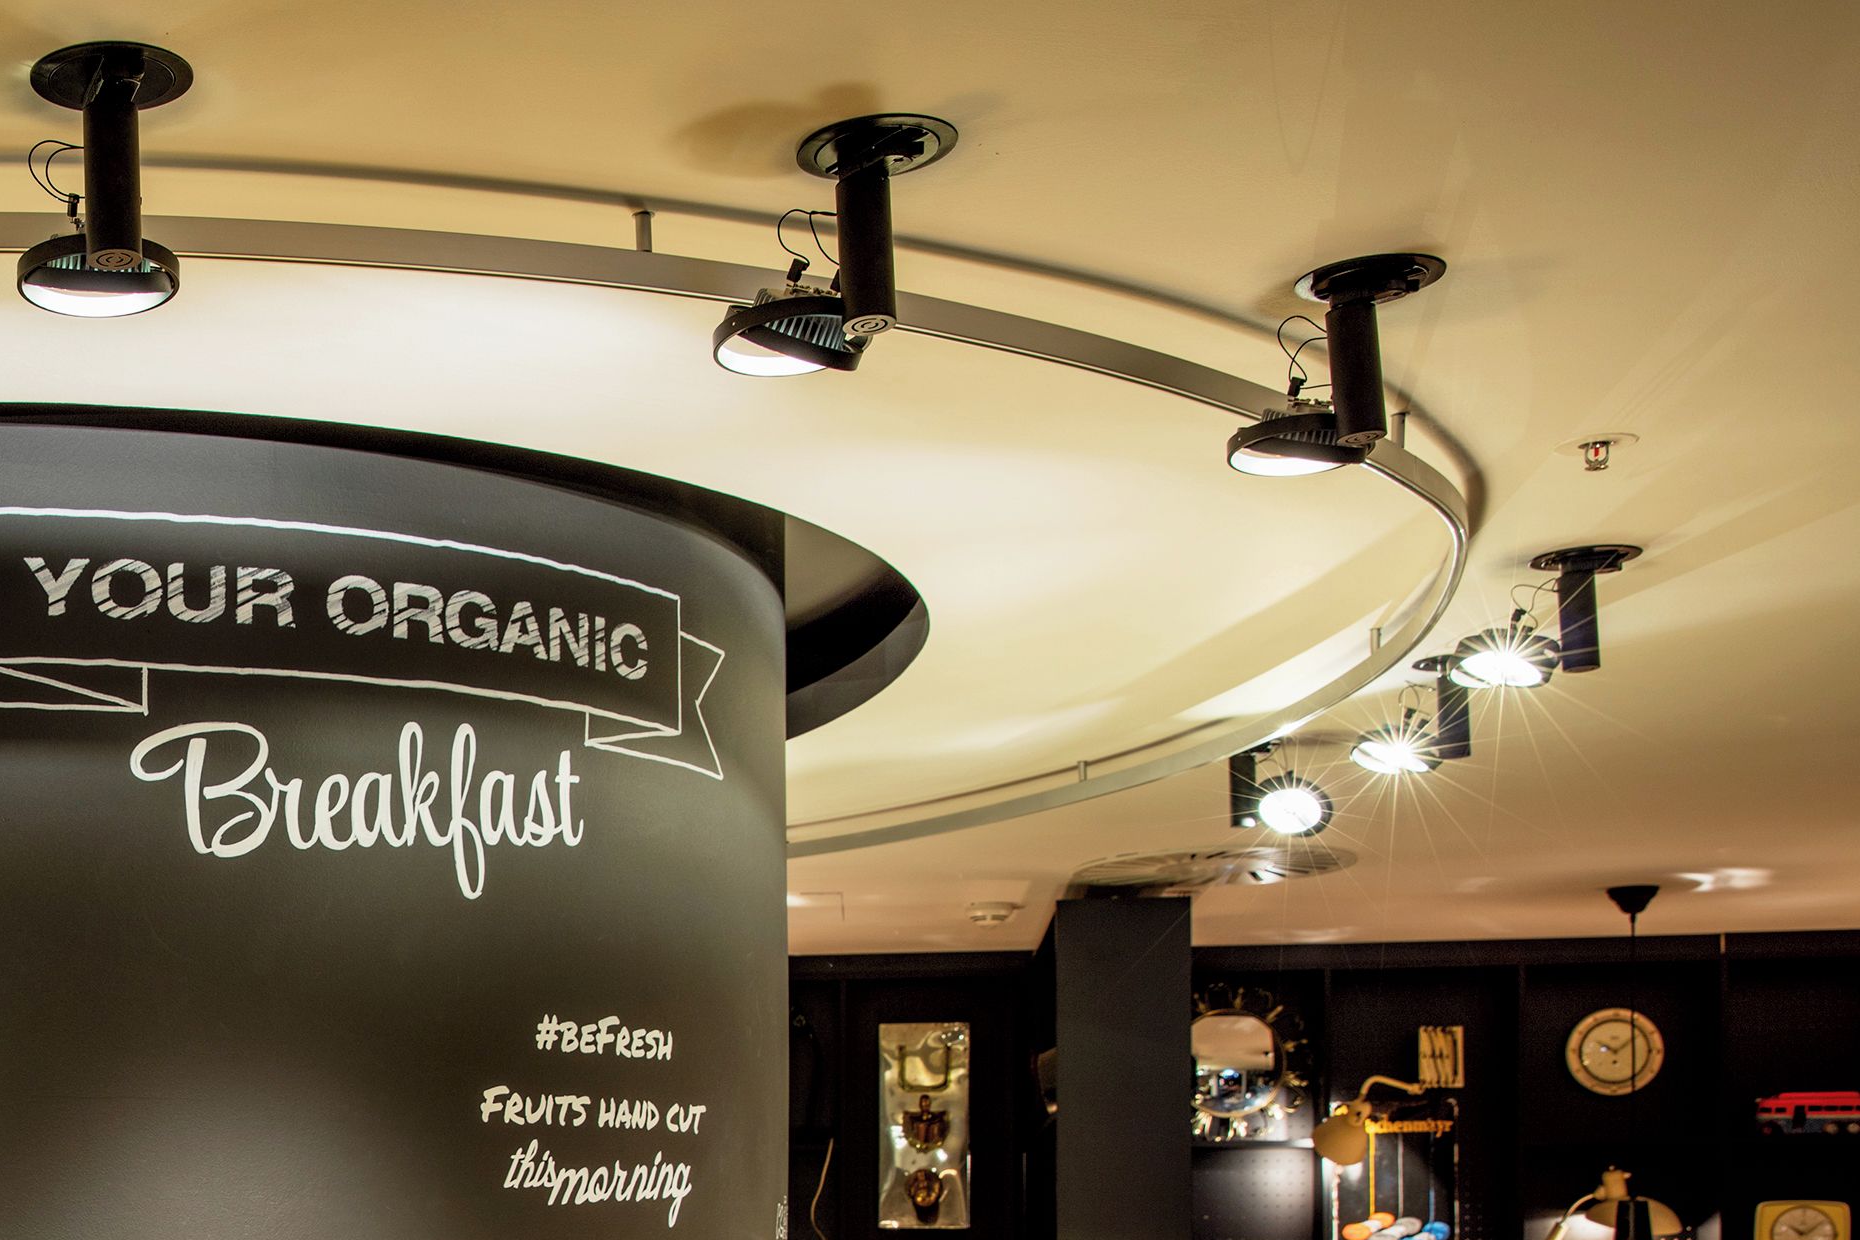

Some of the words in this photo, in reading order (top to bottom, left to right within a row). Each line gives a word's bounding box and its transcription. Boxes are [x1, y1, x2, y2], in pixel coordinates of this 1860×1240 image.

[23, 557, 297, 629] YOUR
[326, 574, 649, 680] ORGANIC
[130, 720, 586, 900] Breakfast
[480, 1084, 591, 1127] FRUITS
[597, 1097, 660, 1131] HAND
[665, 1102, 707, 1135] CUT
